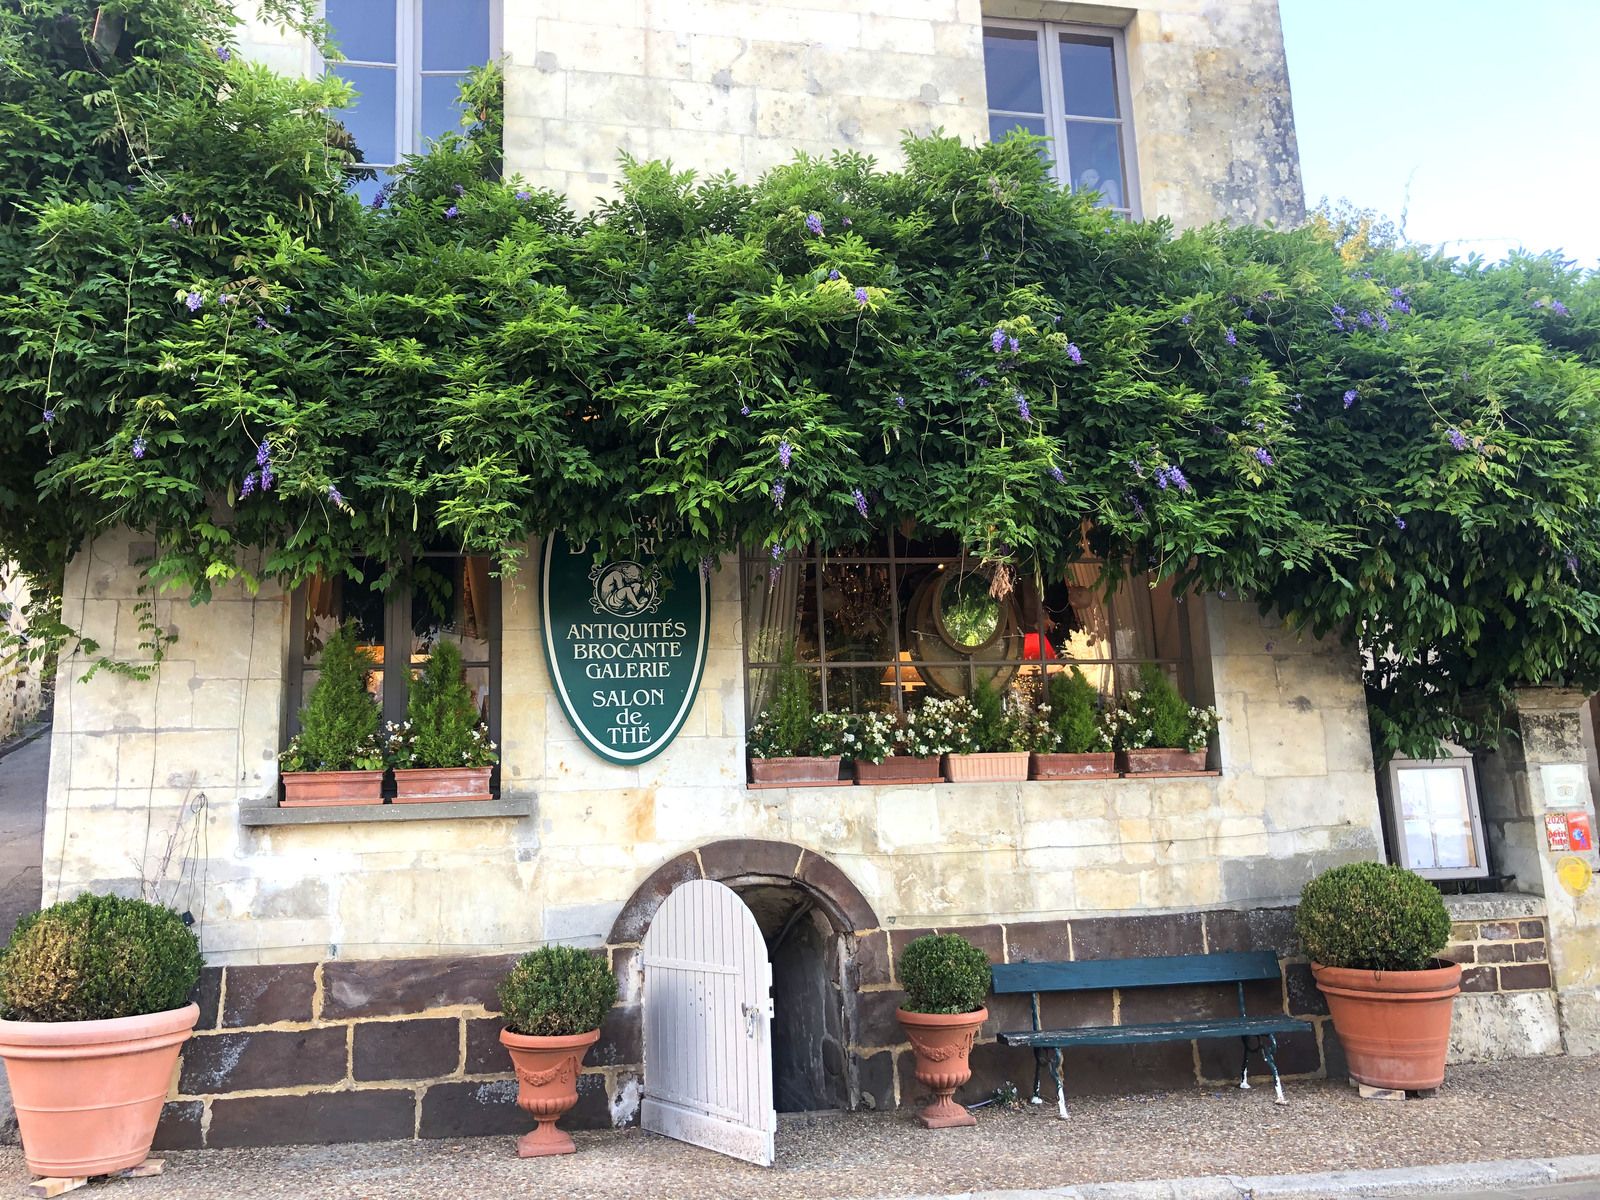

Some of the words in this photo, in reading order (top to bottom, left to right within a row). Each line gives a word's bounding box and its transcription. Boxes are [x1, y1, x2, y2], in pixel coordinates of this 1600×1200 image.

[566, 619, 687, 640] ANTIQUITÉS
[573, 642, 682, 659] BROCANTE
[585, 662, 671, 679] GALERIE
[592, 689, 664, 707] SALON
[615, 708, 642, 725] de
[607, 723, 651, 744] THÉ
[1547, 816, 1565, 824] 2020
